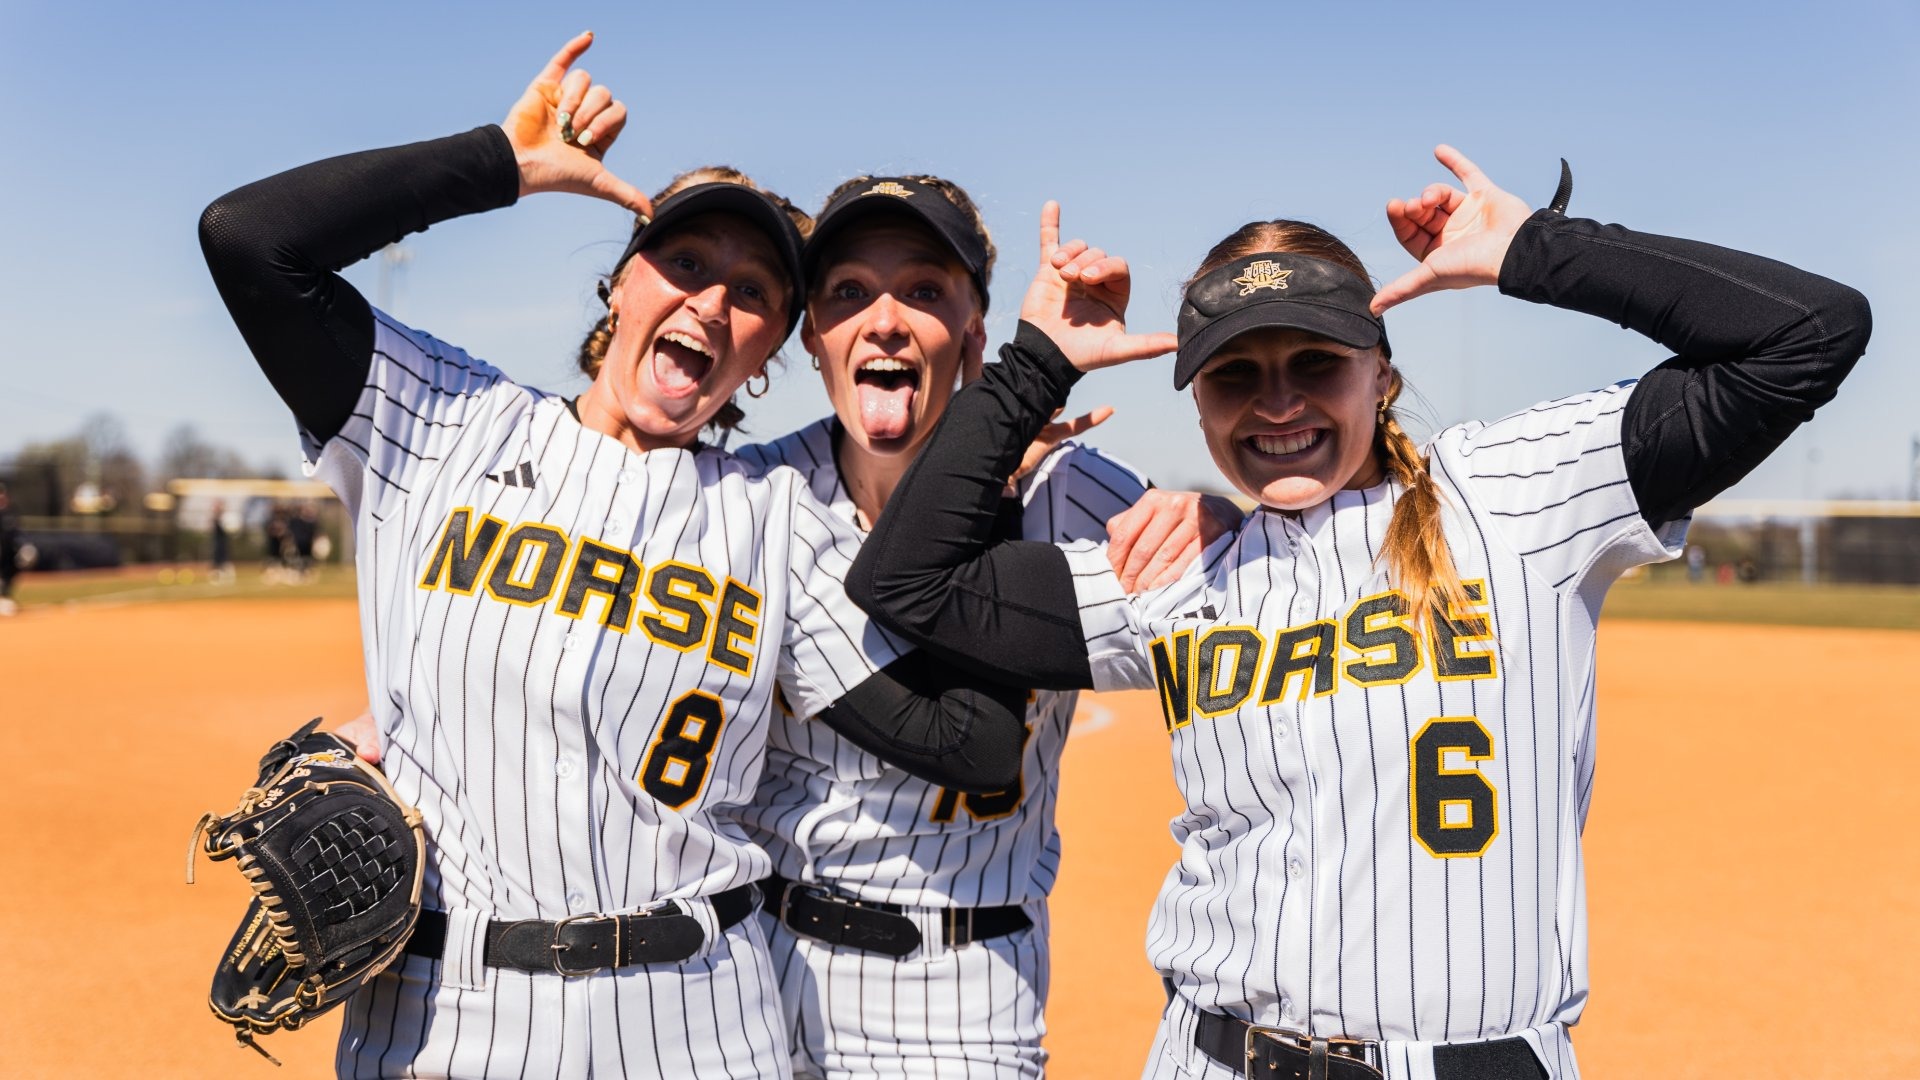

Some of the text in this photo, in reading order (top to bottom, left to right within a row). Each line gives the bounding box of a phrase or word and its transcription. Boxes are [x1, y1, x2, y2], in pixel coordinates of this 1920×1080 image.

[418, 507, 762, 677] NORSE
[1149, 578, 1498, 734] NORSE
[638, 689, 726, 812] 8
[1410, 716, 1499, 859] 6
